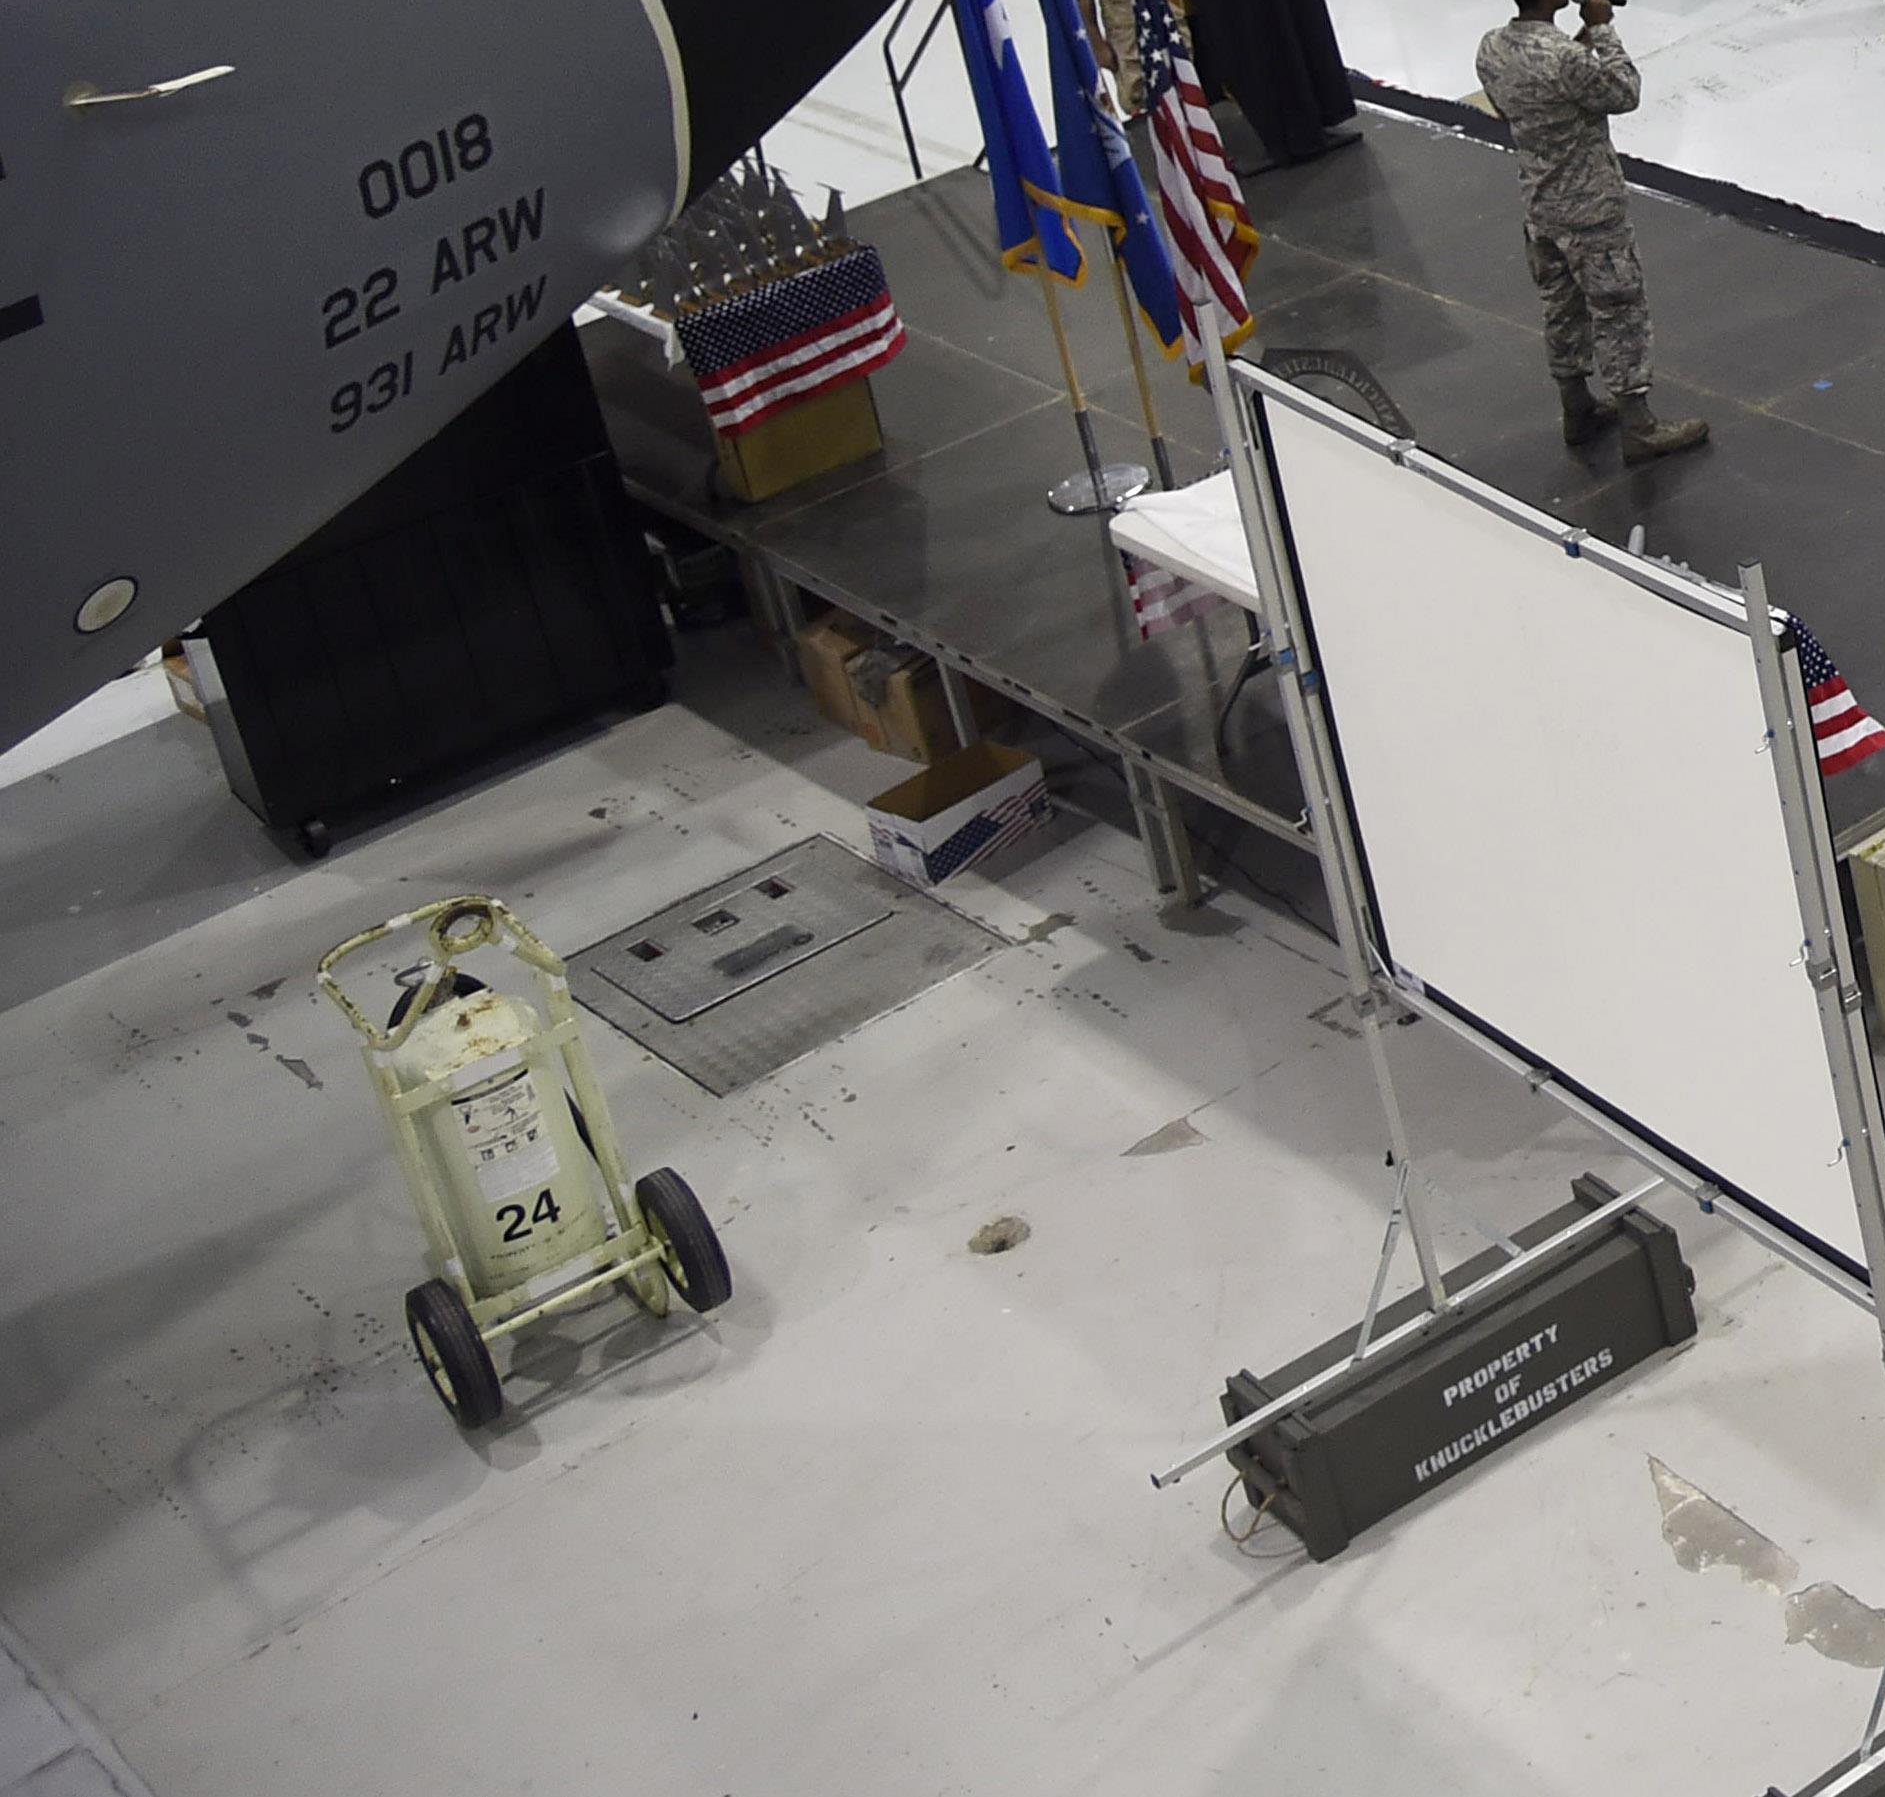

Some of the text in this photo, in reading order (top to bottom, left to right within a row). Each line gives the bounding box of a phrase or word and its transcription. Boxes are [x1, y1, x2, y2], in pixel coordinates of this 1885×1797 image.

[358, 113, 493, 219] 0018
[322, 186, 545, 349] 22 ARW
[330, 274, 546, 433] 931 ARW
[496, 1188, 561, 1242] 24
[1414, 1347, 1614, 1482] KNUCKLEBUSTERS
[1443, 1323, 1560, 1408] PROPERTY
[1494, 1373, 1522, 1404] OF
